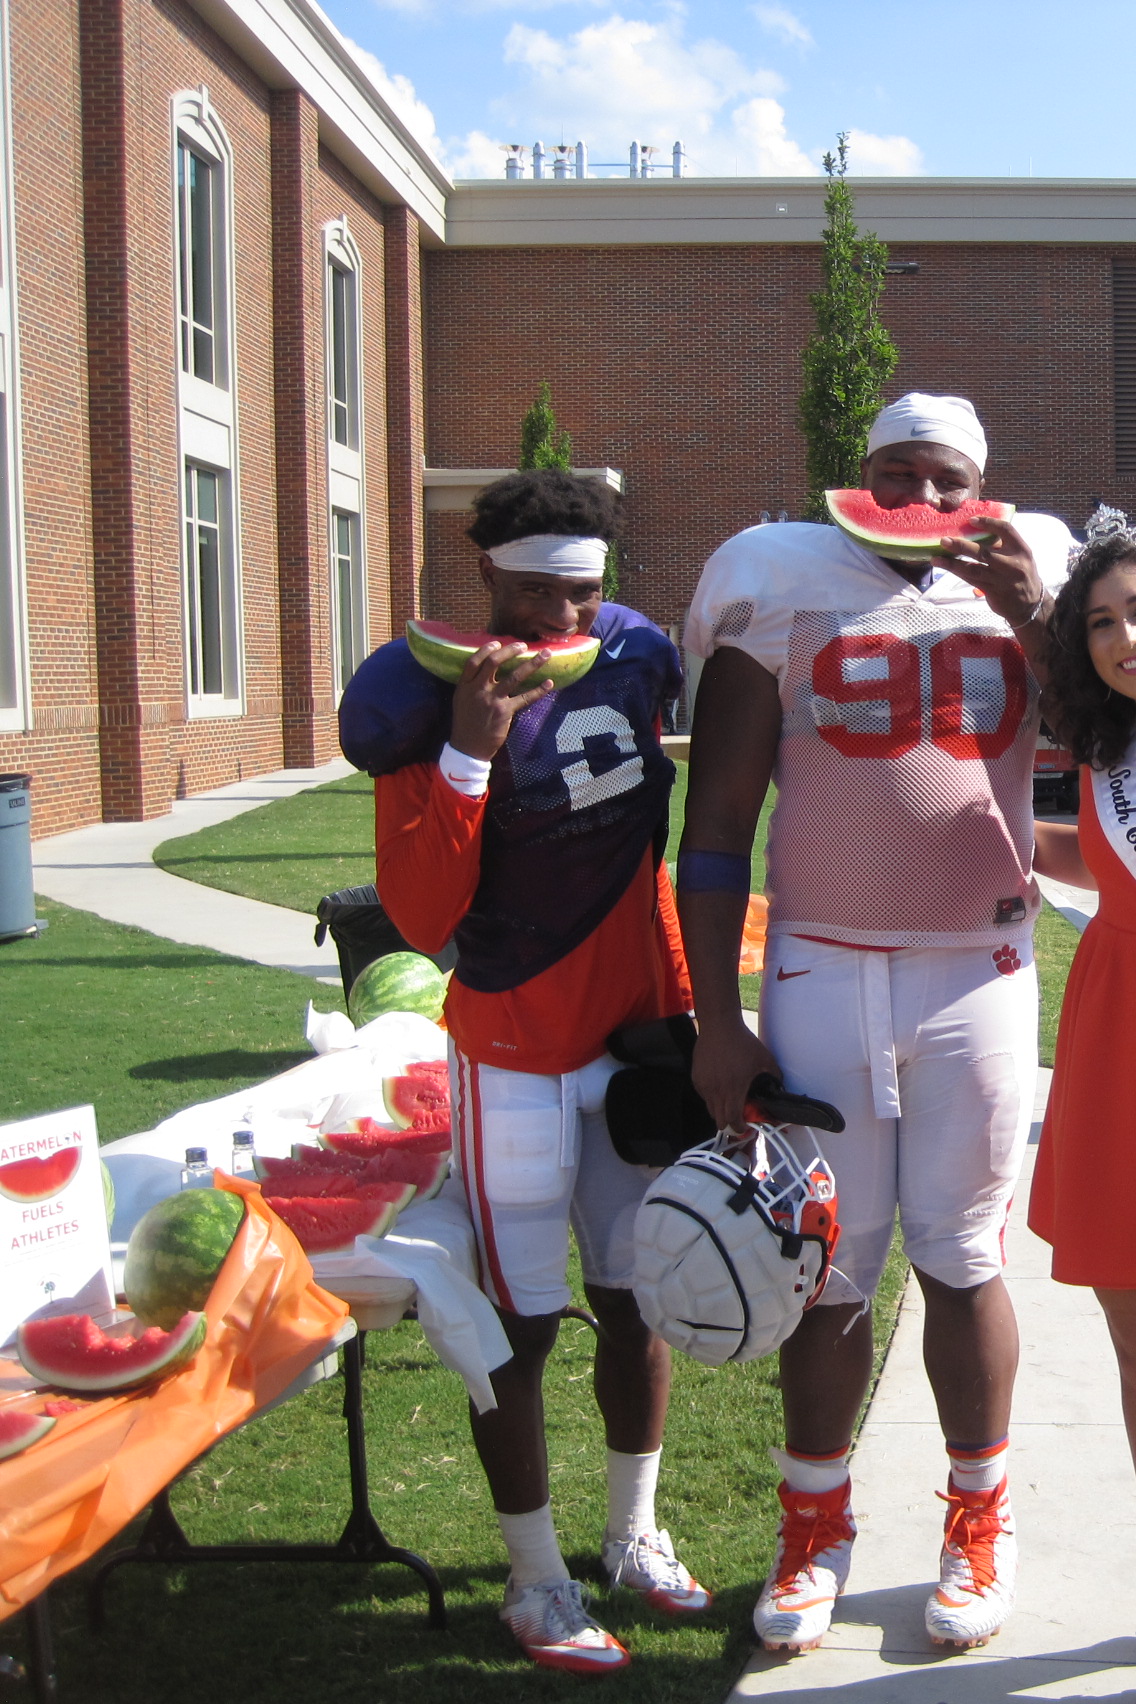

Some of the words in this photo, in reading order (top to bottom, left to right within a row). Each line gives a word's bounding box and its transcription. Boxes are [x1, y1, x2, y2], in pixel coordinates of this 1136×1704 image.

[811, 632, 1029, 761] 90
[555, 704, 645, 812] 2
[0, 1130, 83, 1161] ATERMELN
[22, 1200, 64, 1223] FUELS
[10, 1219, 80, 1250] ATHLETES
